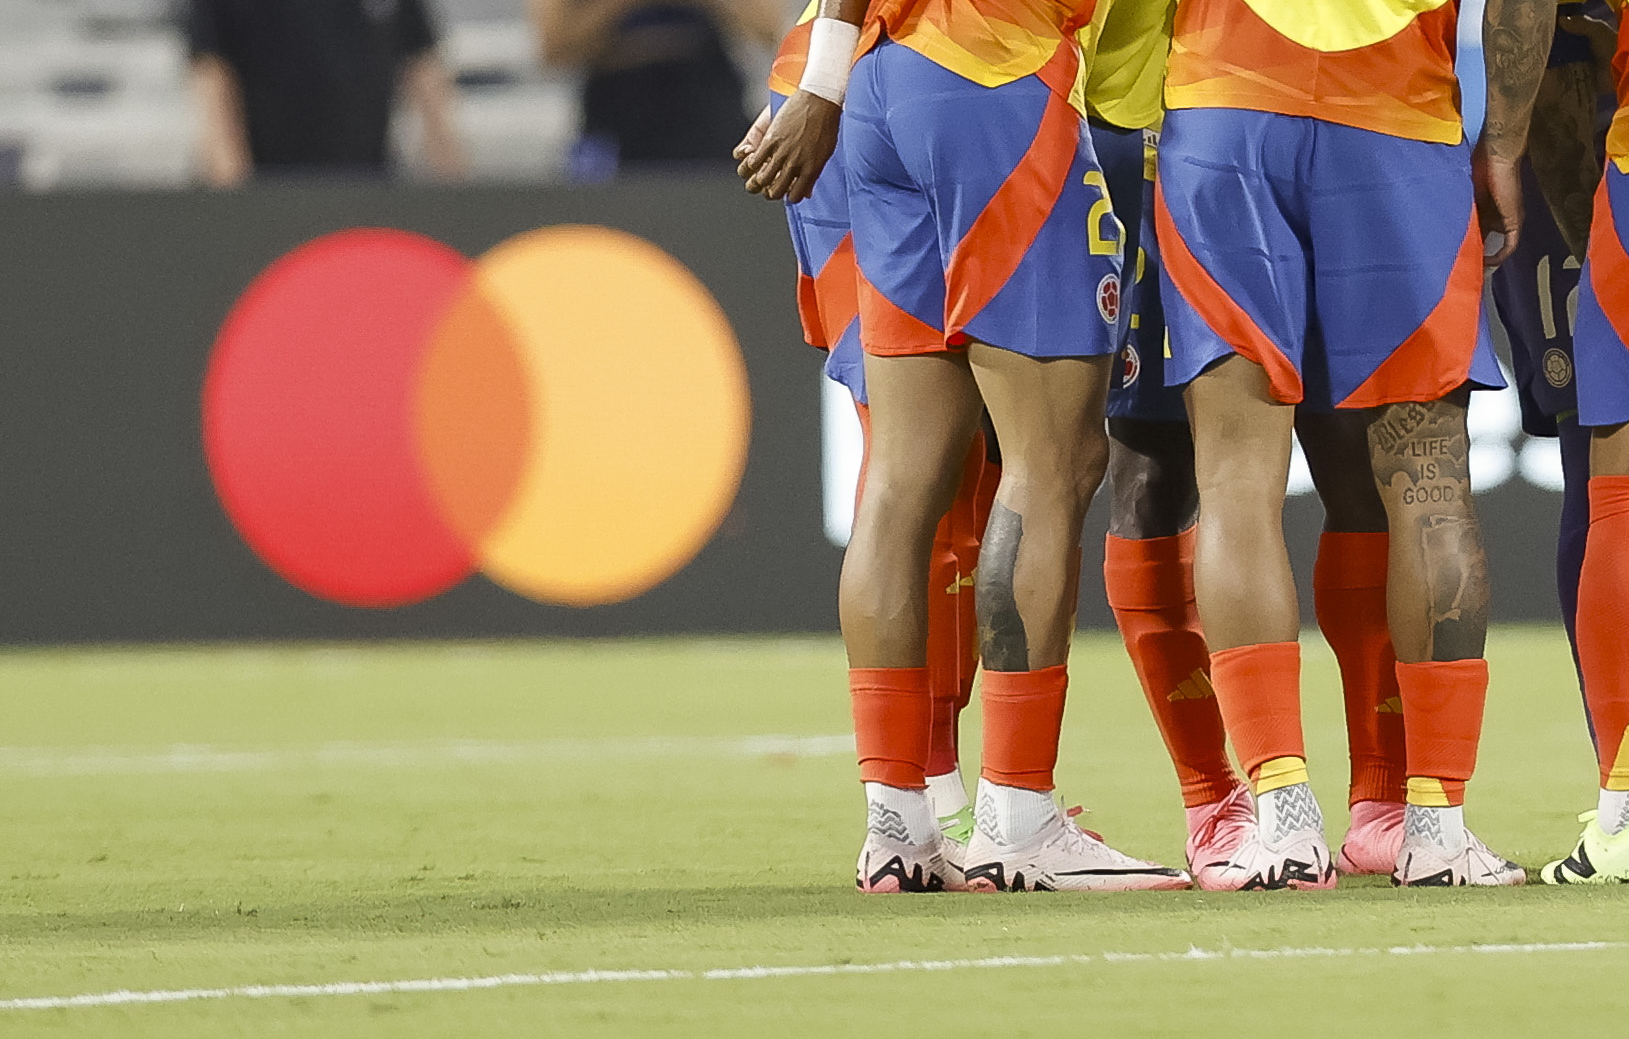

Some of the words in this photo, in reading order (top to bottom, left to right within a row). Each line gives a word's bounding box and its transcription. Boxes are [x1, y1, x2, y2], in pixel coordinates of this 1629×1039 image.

[1411, 439, 1449, 457] LIFE
[1420, 463, 1437, 480] IS
[1402, 485, 1454, 505] GOOD
